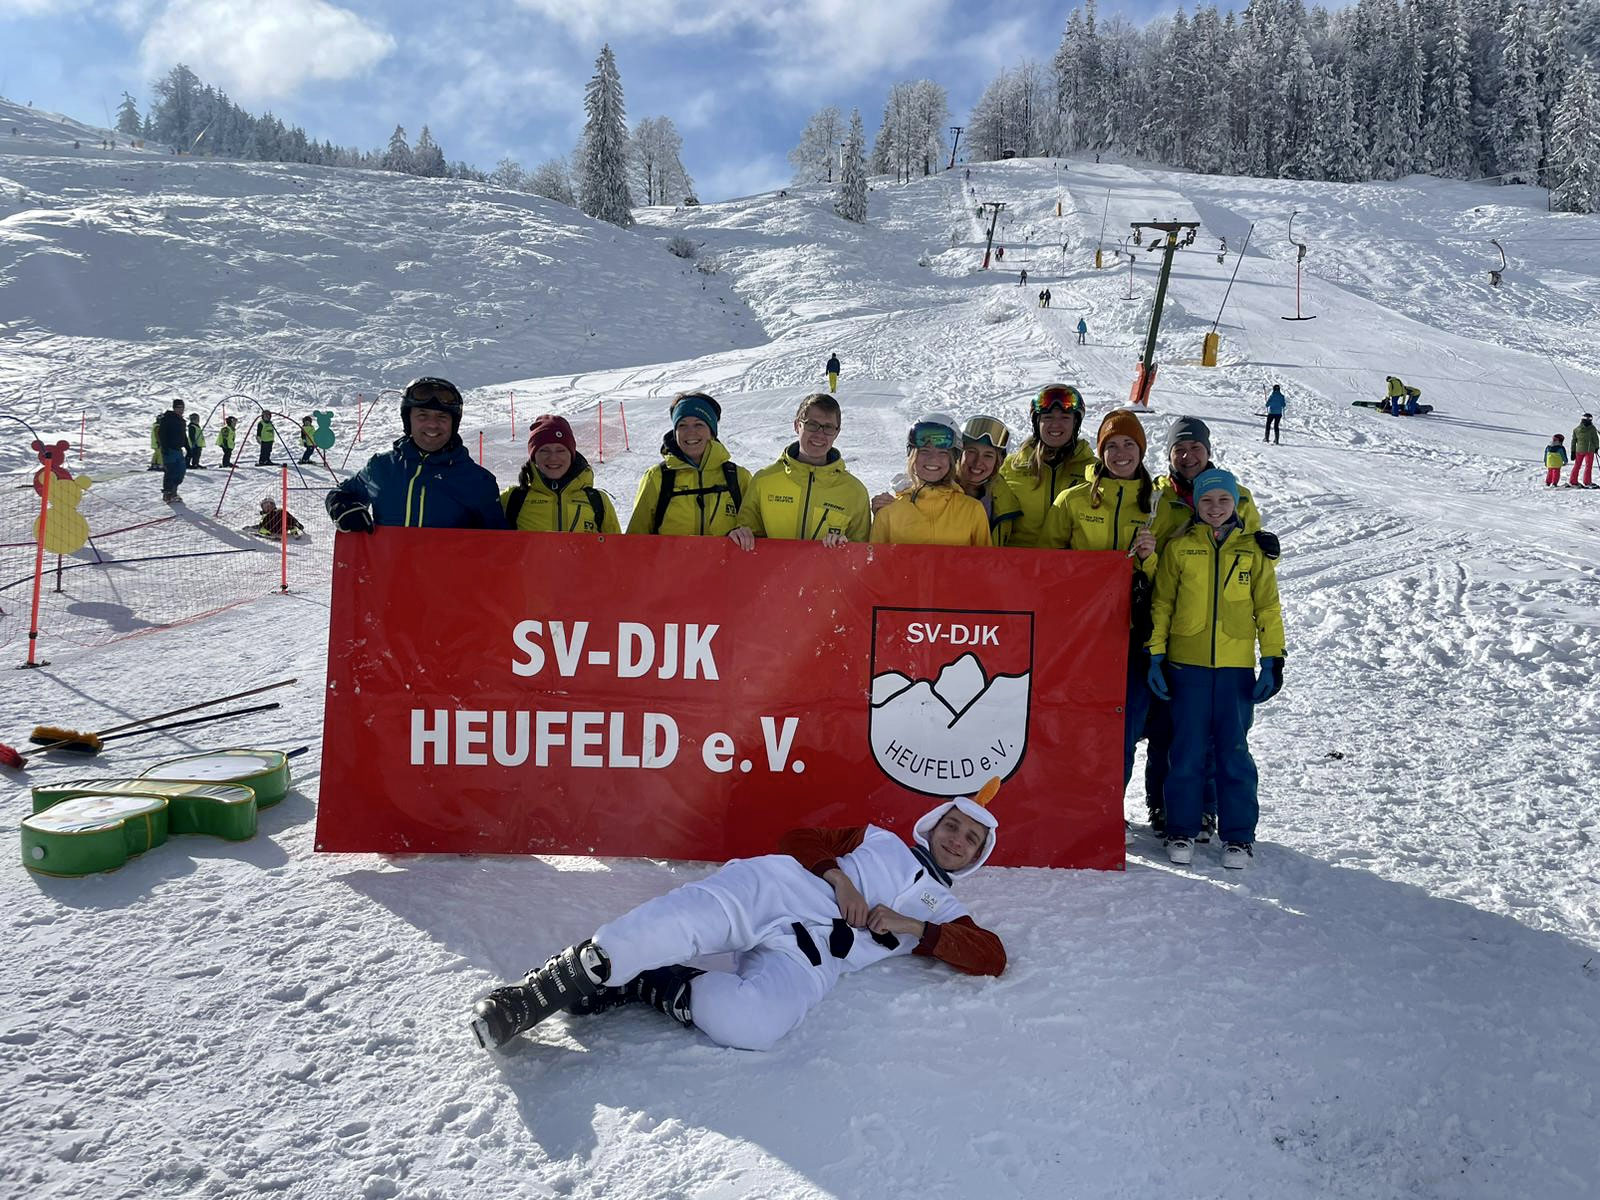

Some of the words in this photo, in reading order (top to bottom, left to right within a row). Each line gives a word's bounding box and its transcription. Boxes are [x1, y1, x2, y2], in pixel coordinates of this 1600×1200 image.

[511, 619, 721, 681] SV-DJK
[906, 622, 1000, 646] SV-DJK
[410, 709, 680, 769] HEUFELD
[701, 716, 805, 774] e.V.
[885, 739, 975, 780] HEUFELD
[980, 739, 1013, 771] e.V.
